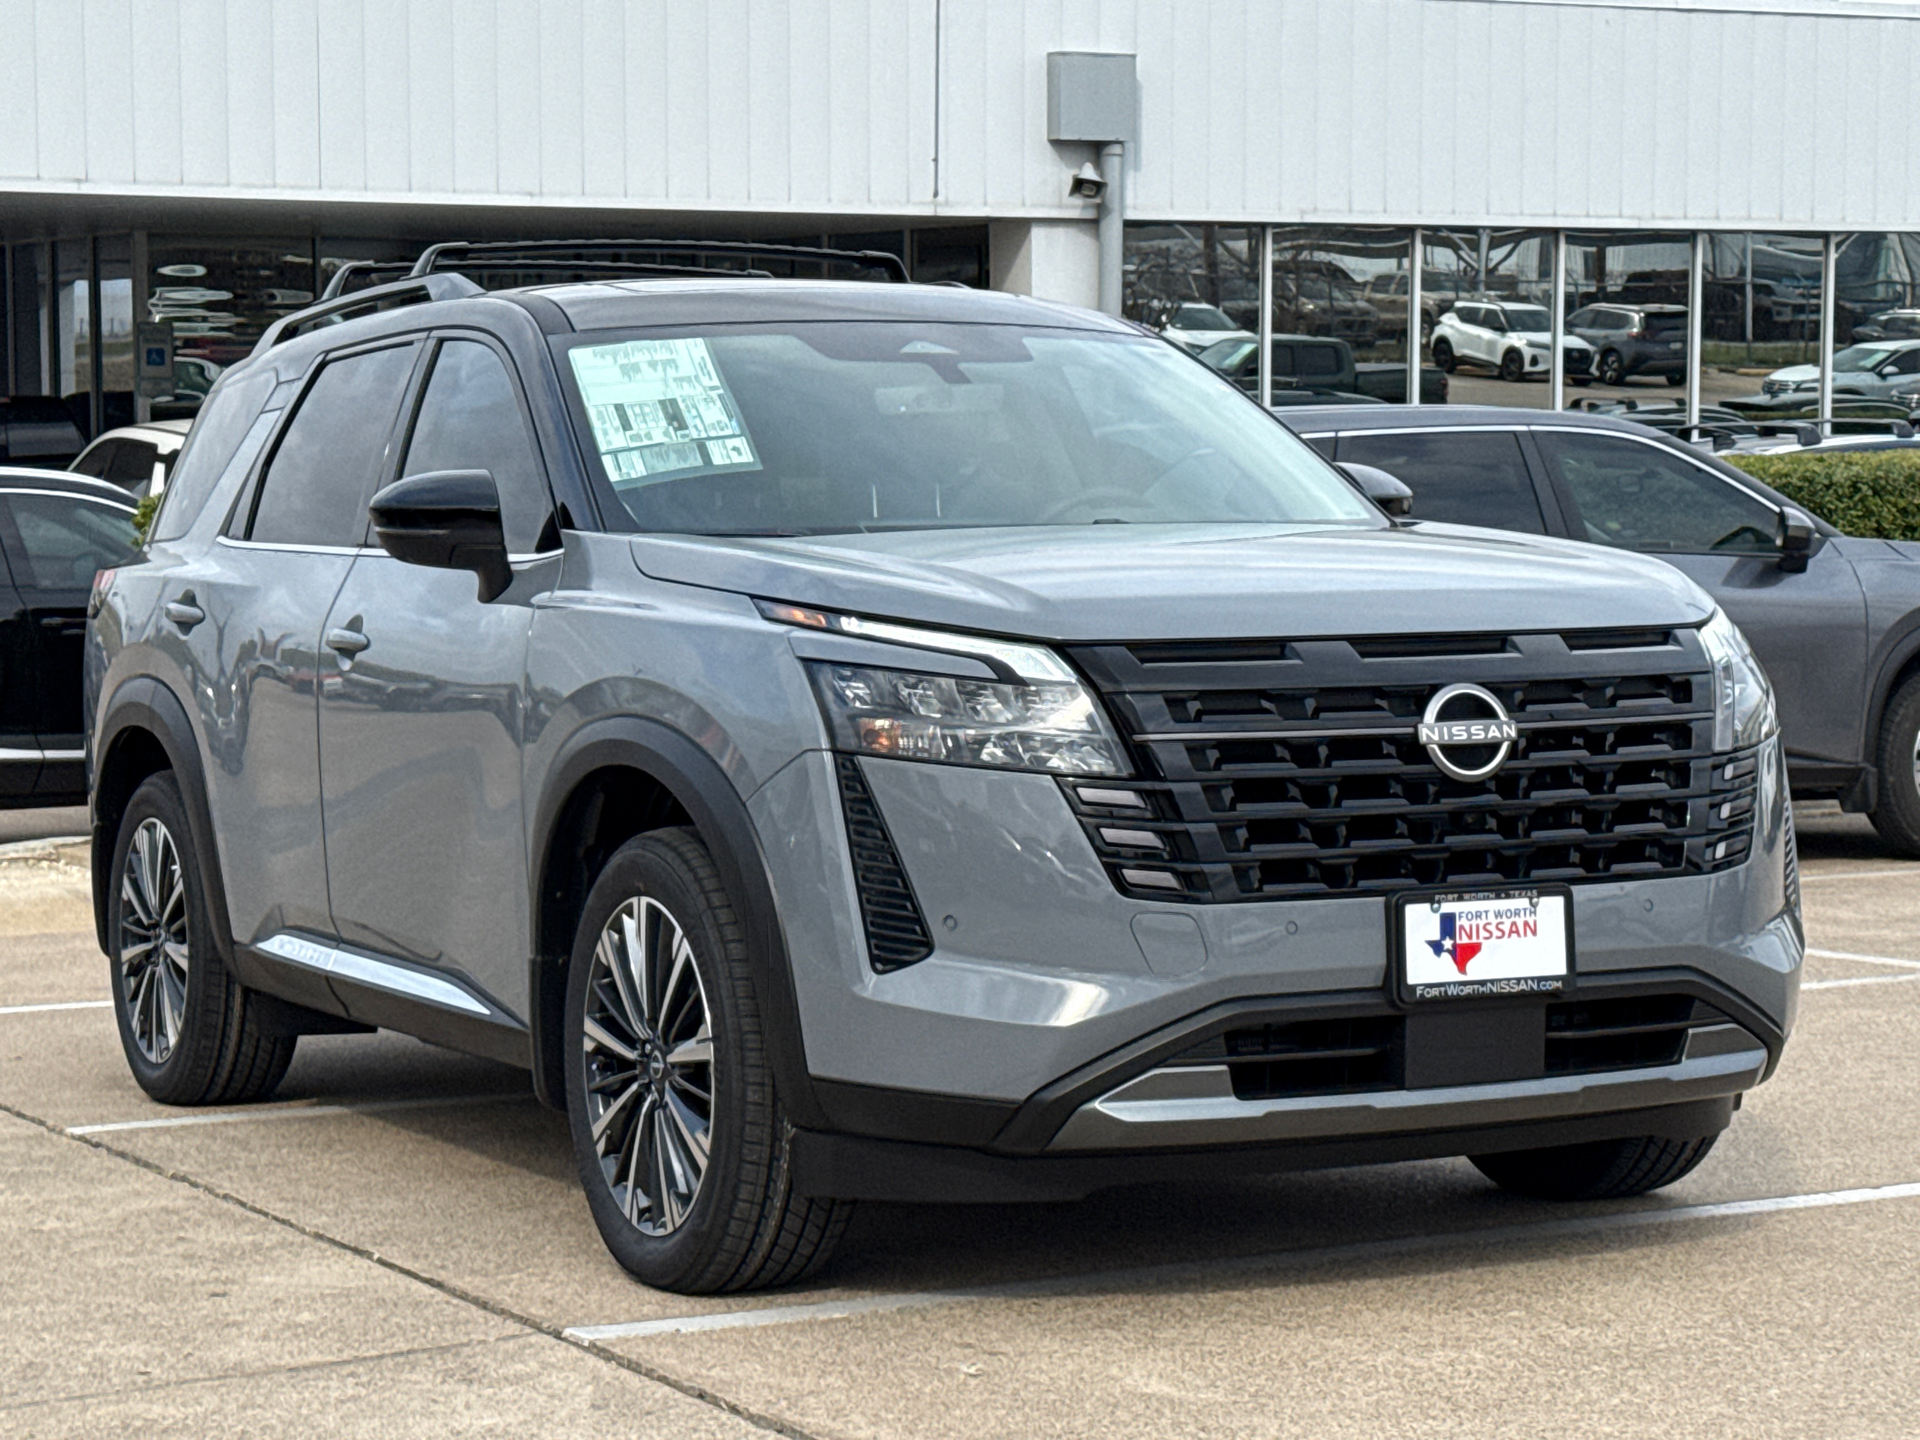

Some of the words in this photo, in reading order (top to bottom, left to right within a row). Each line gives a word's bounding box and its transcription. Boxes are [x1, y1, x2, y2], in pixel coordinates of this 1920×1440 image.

[1421, 724, 1516, 742] NISSAN
[1434, 893, 1459, 902] FORT
[1463, 892, 1495, 901] WORTH
[1509, 889, 1538, 898] TEXAS
[1458, 910, 1490, 922] FORT
[1494, 907, 1537, 919] WORTH
[1458, 919, 1538, 941] NISSAN
